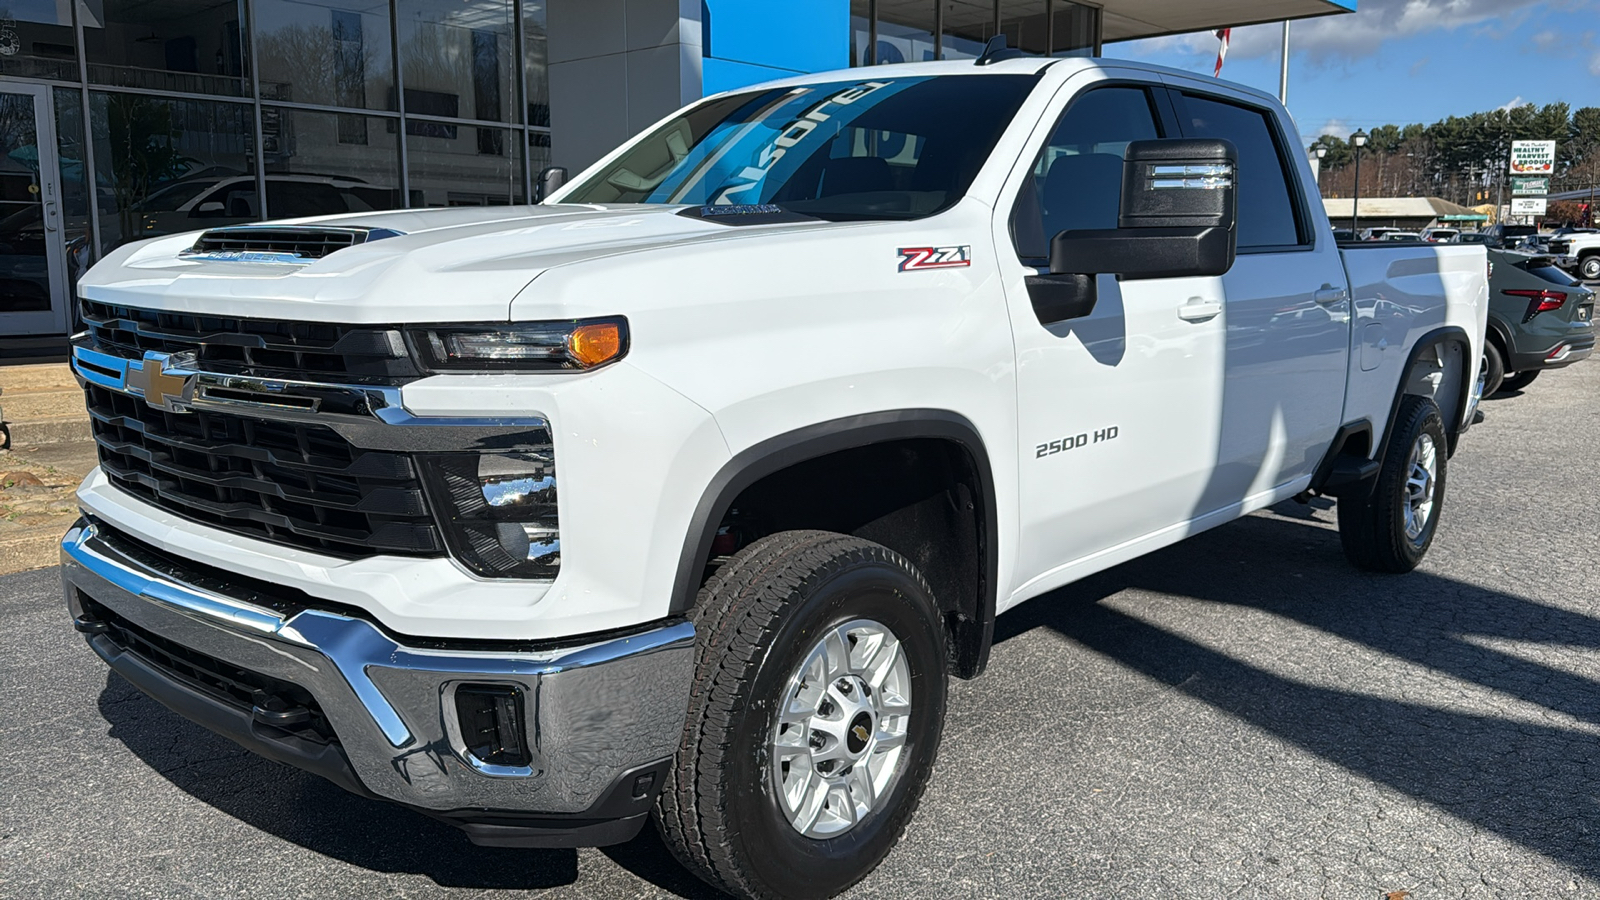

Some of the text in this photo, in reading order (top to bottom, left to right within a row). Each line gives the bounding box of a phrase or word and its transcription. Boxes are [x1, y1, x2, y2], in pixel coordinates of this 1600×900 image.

[208, 251, 280, 261] CHEVROLET
[896, 244, 971, 273] Z71
[1035, 426, 1119, 459] 2500 HD
